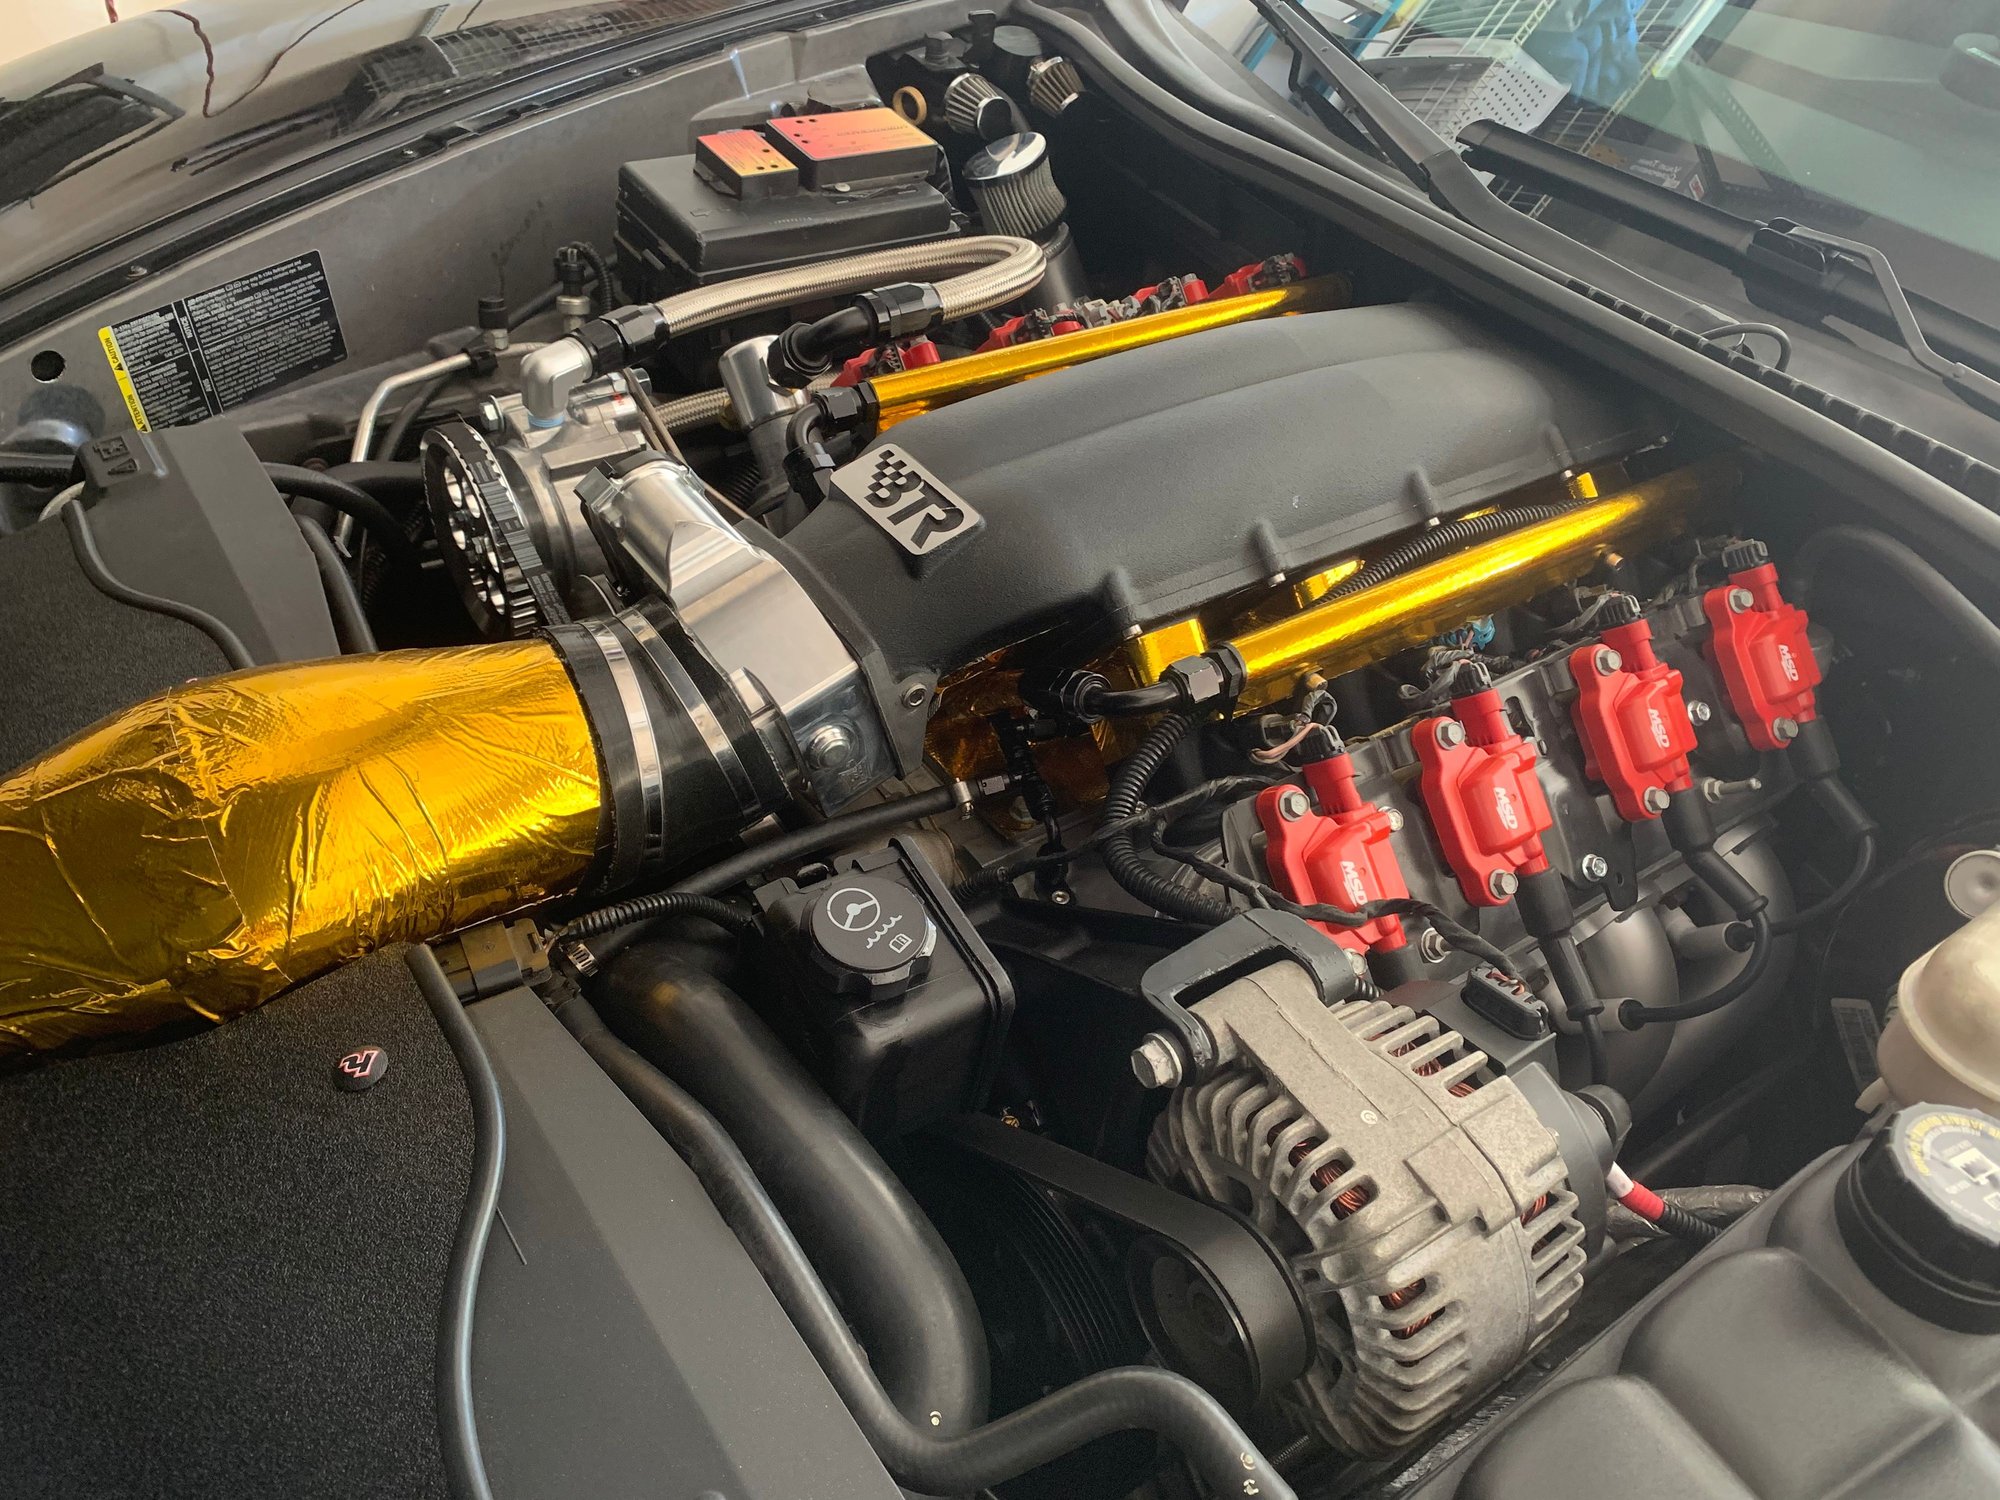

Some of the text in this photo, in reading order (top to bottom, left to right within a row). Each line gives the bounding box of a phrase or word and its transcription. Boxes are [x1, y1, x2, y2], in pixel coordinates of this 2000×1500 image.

[180, 315, 193, 339] NOTICE
[104, 337, 120, 364] CAUTION
[127, 393, 144, 426] ATTENTION
[863, 448, 965, 550] BTR
[1778, 644, 1799, 682] MSD
[1647, 707, 1671, 749] MSD
[1493, 786, 1519, 830] MSD
[1339, 860, 1369, 906] MSD
